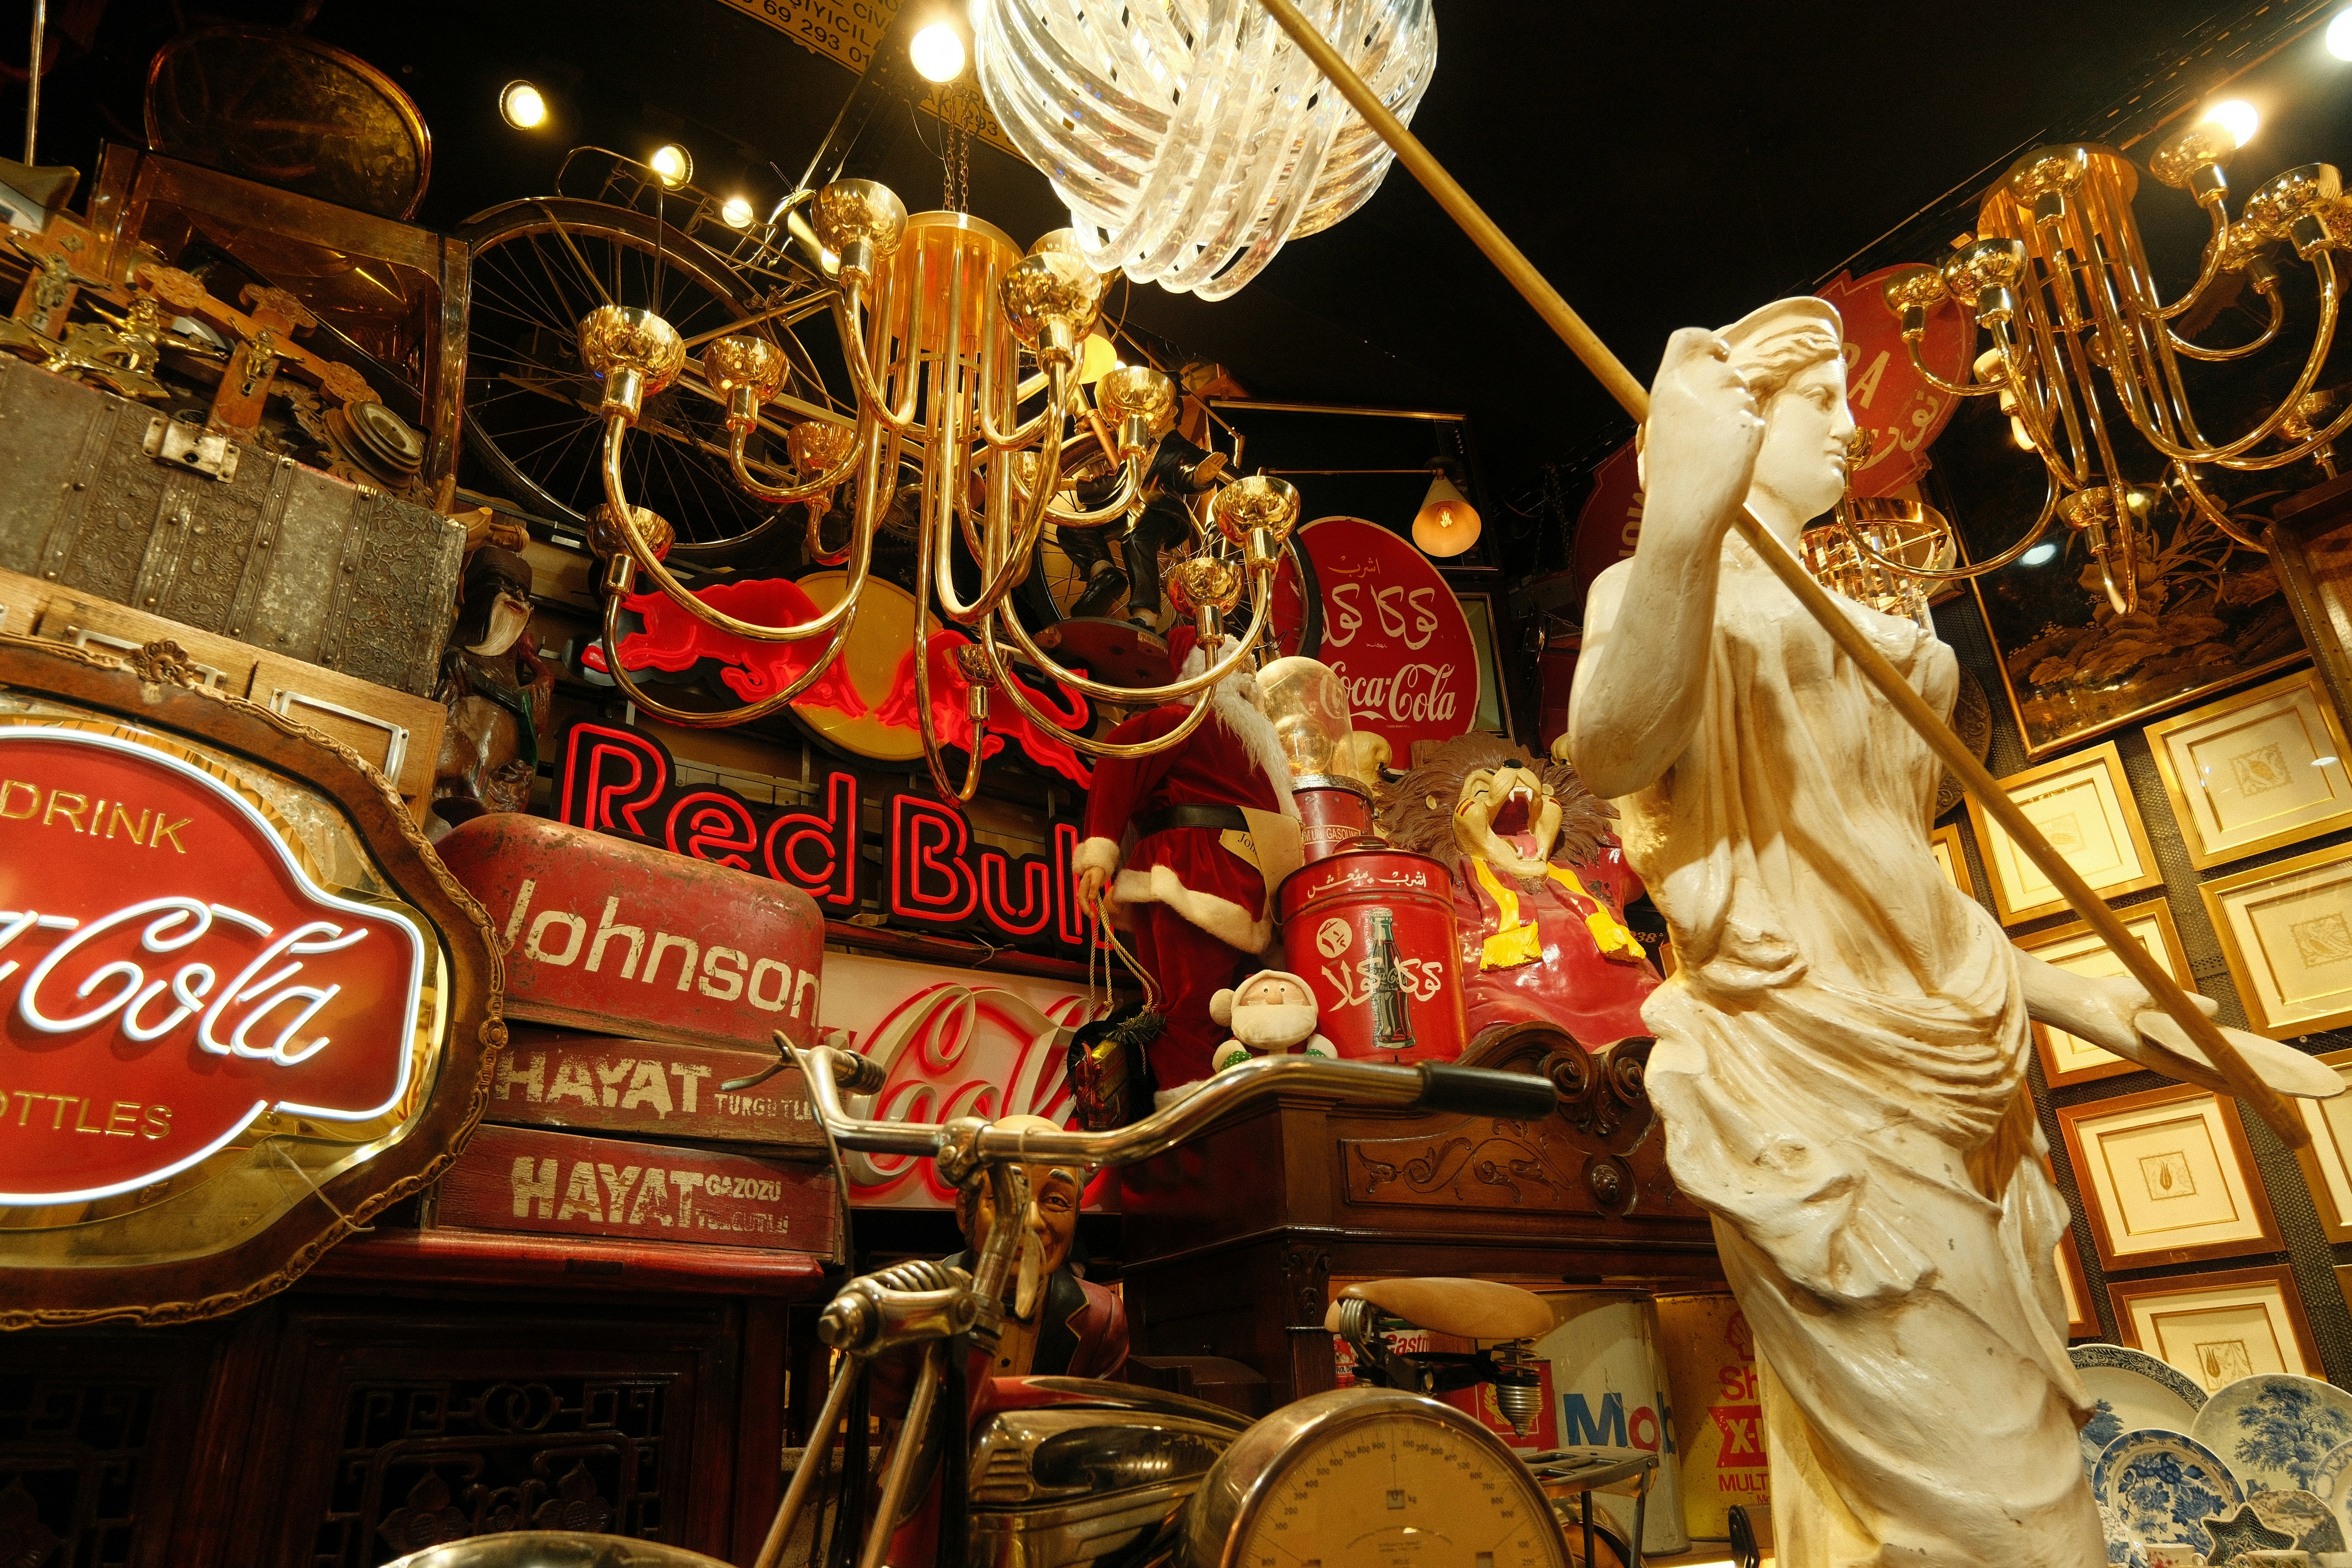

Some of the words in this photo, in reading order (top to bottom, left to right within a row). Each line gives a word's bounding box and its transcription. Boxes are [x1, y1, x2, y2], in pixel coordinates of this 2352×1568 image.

[801, 19, 840, 51] 293
[0, 779, 194, 853] DRINK
[559, 723, 856, 905] Red
[892, 793, 1114, 950] Bul
[502, 879, 819, 1027] Johnson
[494, 1051, 712, 1120] HAYAT
[511, 1156, 704, 1228] HAYAT
[704, 1174, 781, 1202] GAZOZU
